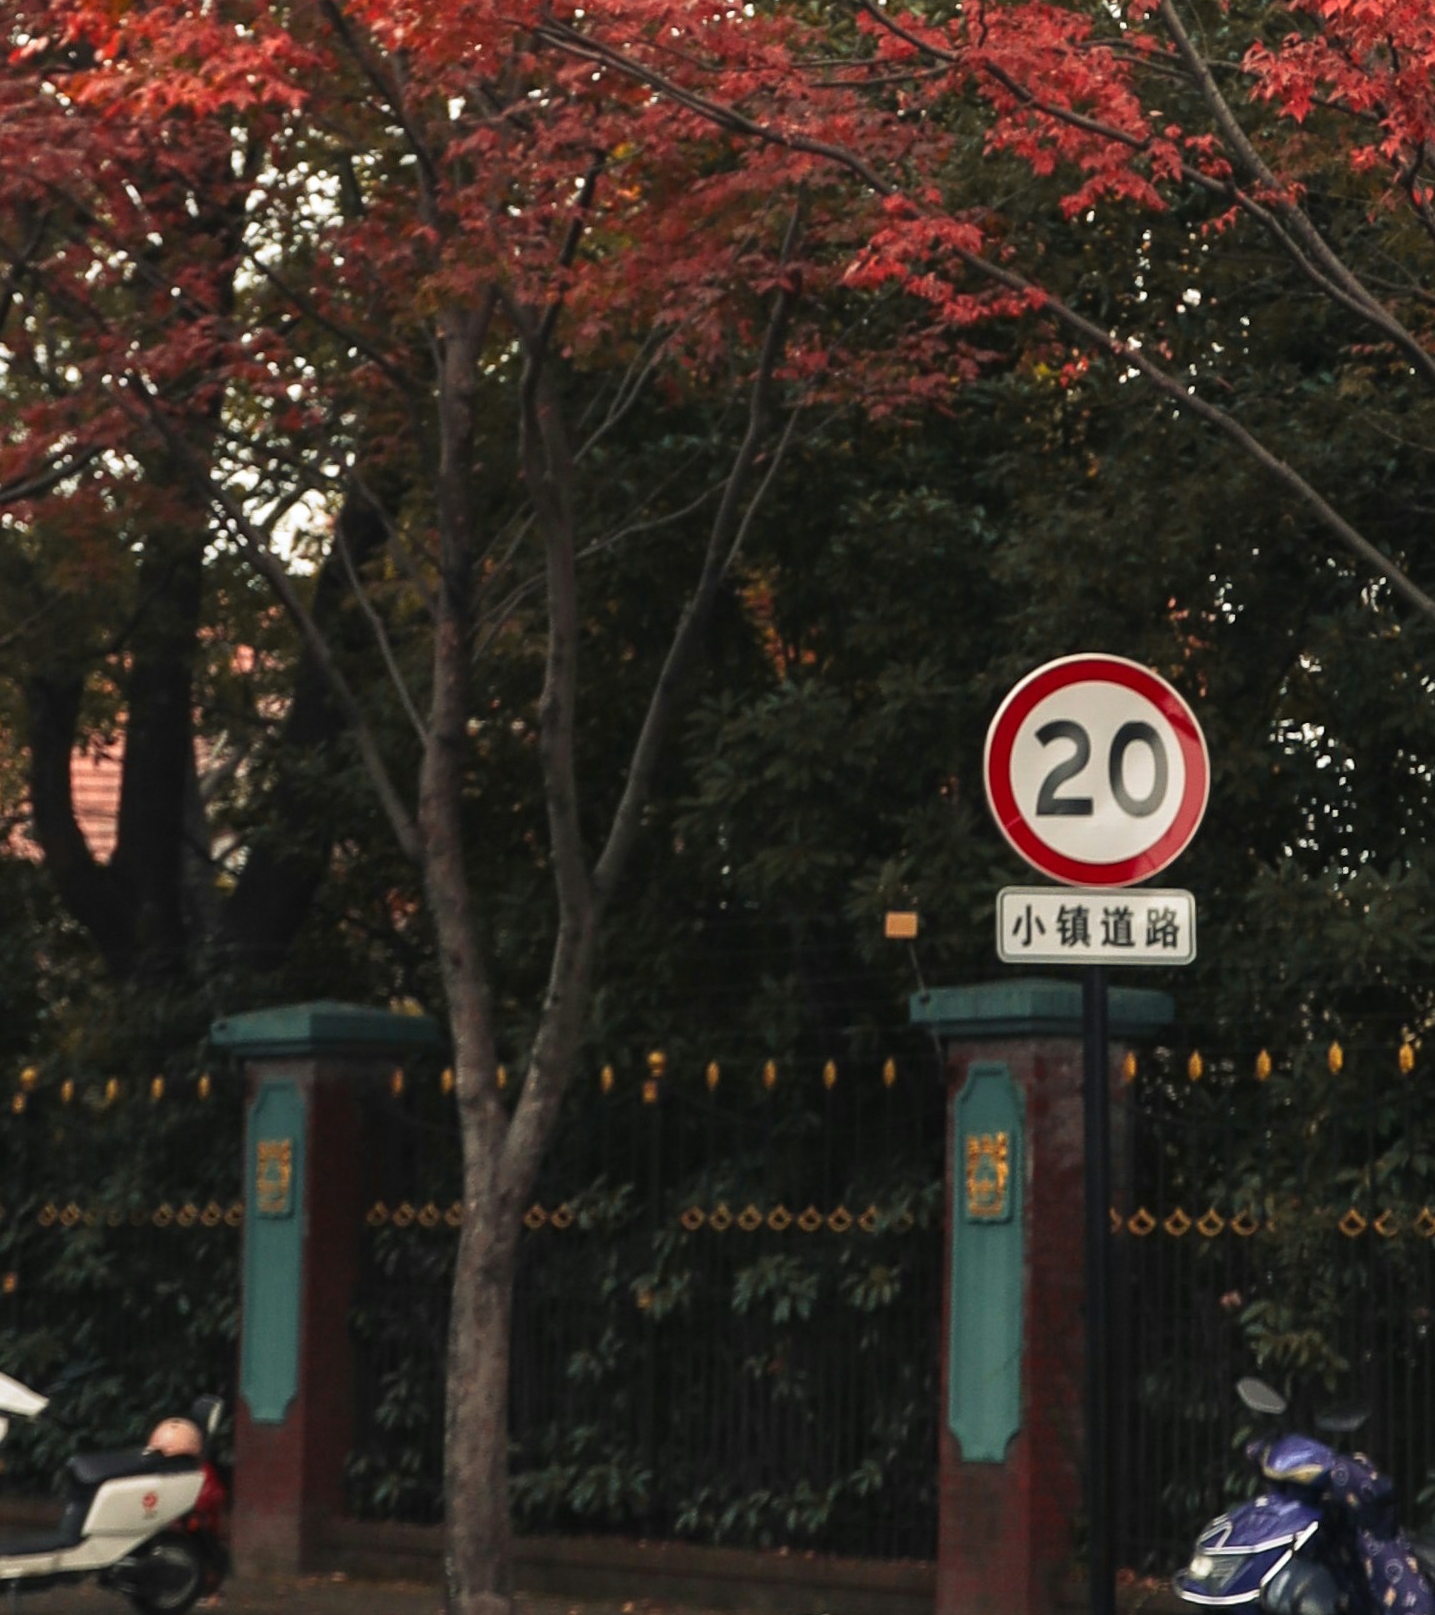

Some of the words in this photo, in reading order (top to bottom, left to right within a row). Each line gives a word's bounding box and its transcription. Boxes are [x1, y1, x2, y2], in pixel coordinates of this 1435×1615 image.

[1035, 720, 1169, 818] 20
[1012, 904, 1180, 949] 小镇道路
